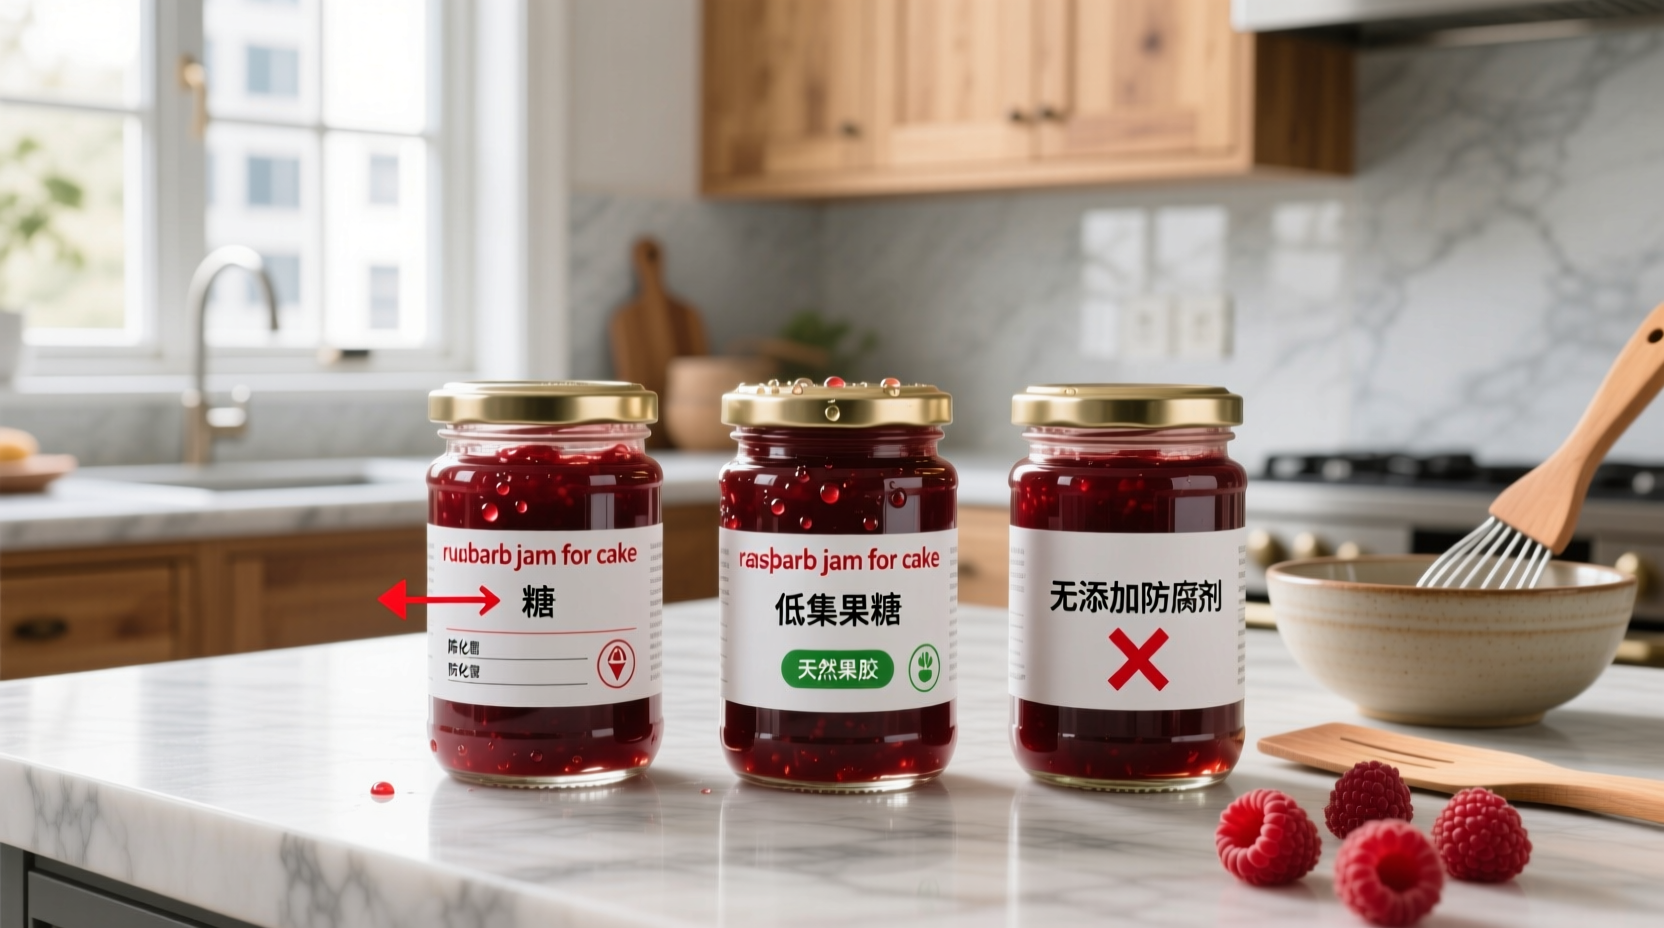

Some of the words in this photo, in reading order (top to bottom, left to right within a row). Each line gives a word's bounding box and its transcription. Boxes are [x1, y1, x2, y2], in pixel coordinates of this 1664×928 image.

[514, 544, 556, 572] jam
[561, 543, 591, 565] for
[596, 542, 637, 565] cake
[820, 549, 862, 576] jam
[868, 548, 897, 570] for
[902, 546, 940, 569] cake
[522, 584, 555, 618] 糖
[775, 591, 902, 627] 低集果糖
[1050, 579, 1222, 614] 无添加防腐剂
[798, 658, 878, 681] 天然果胶
